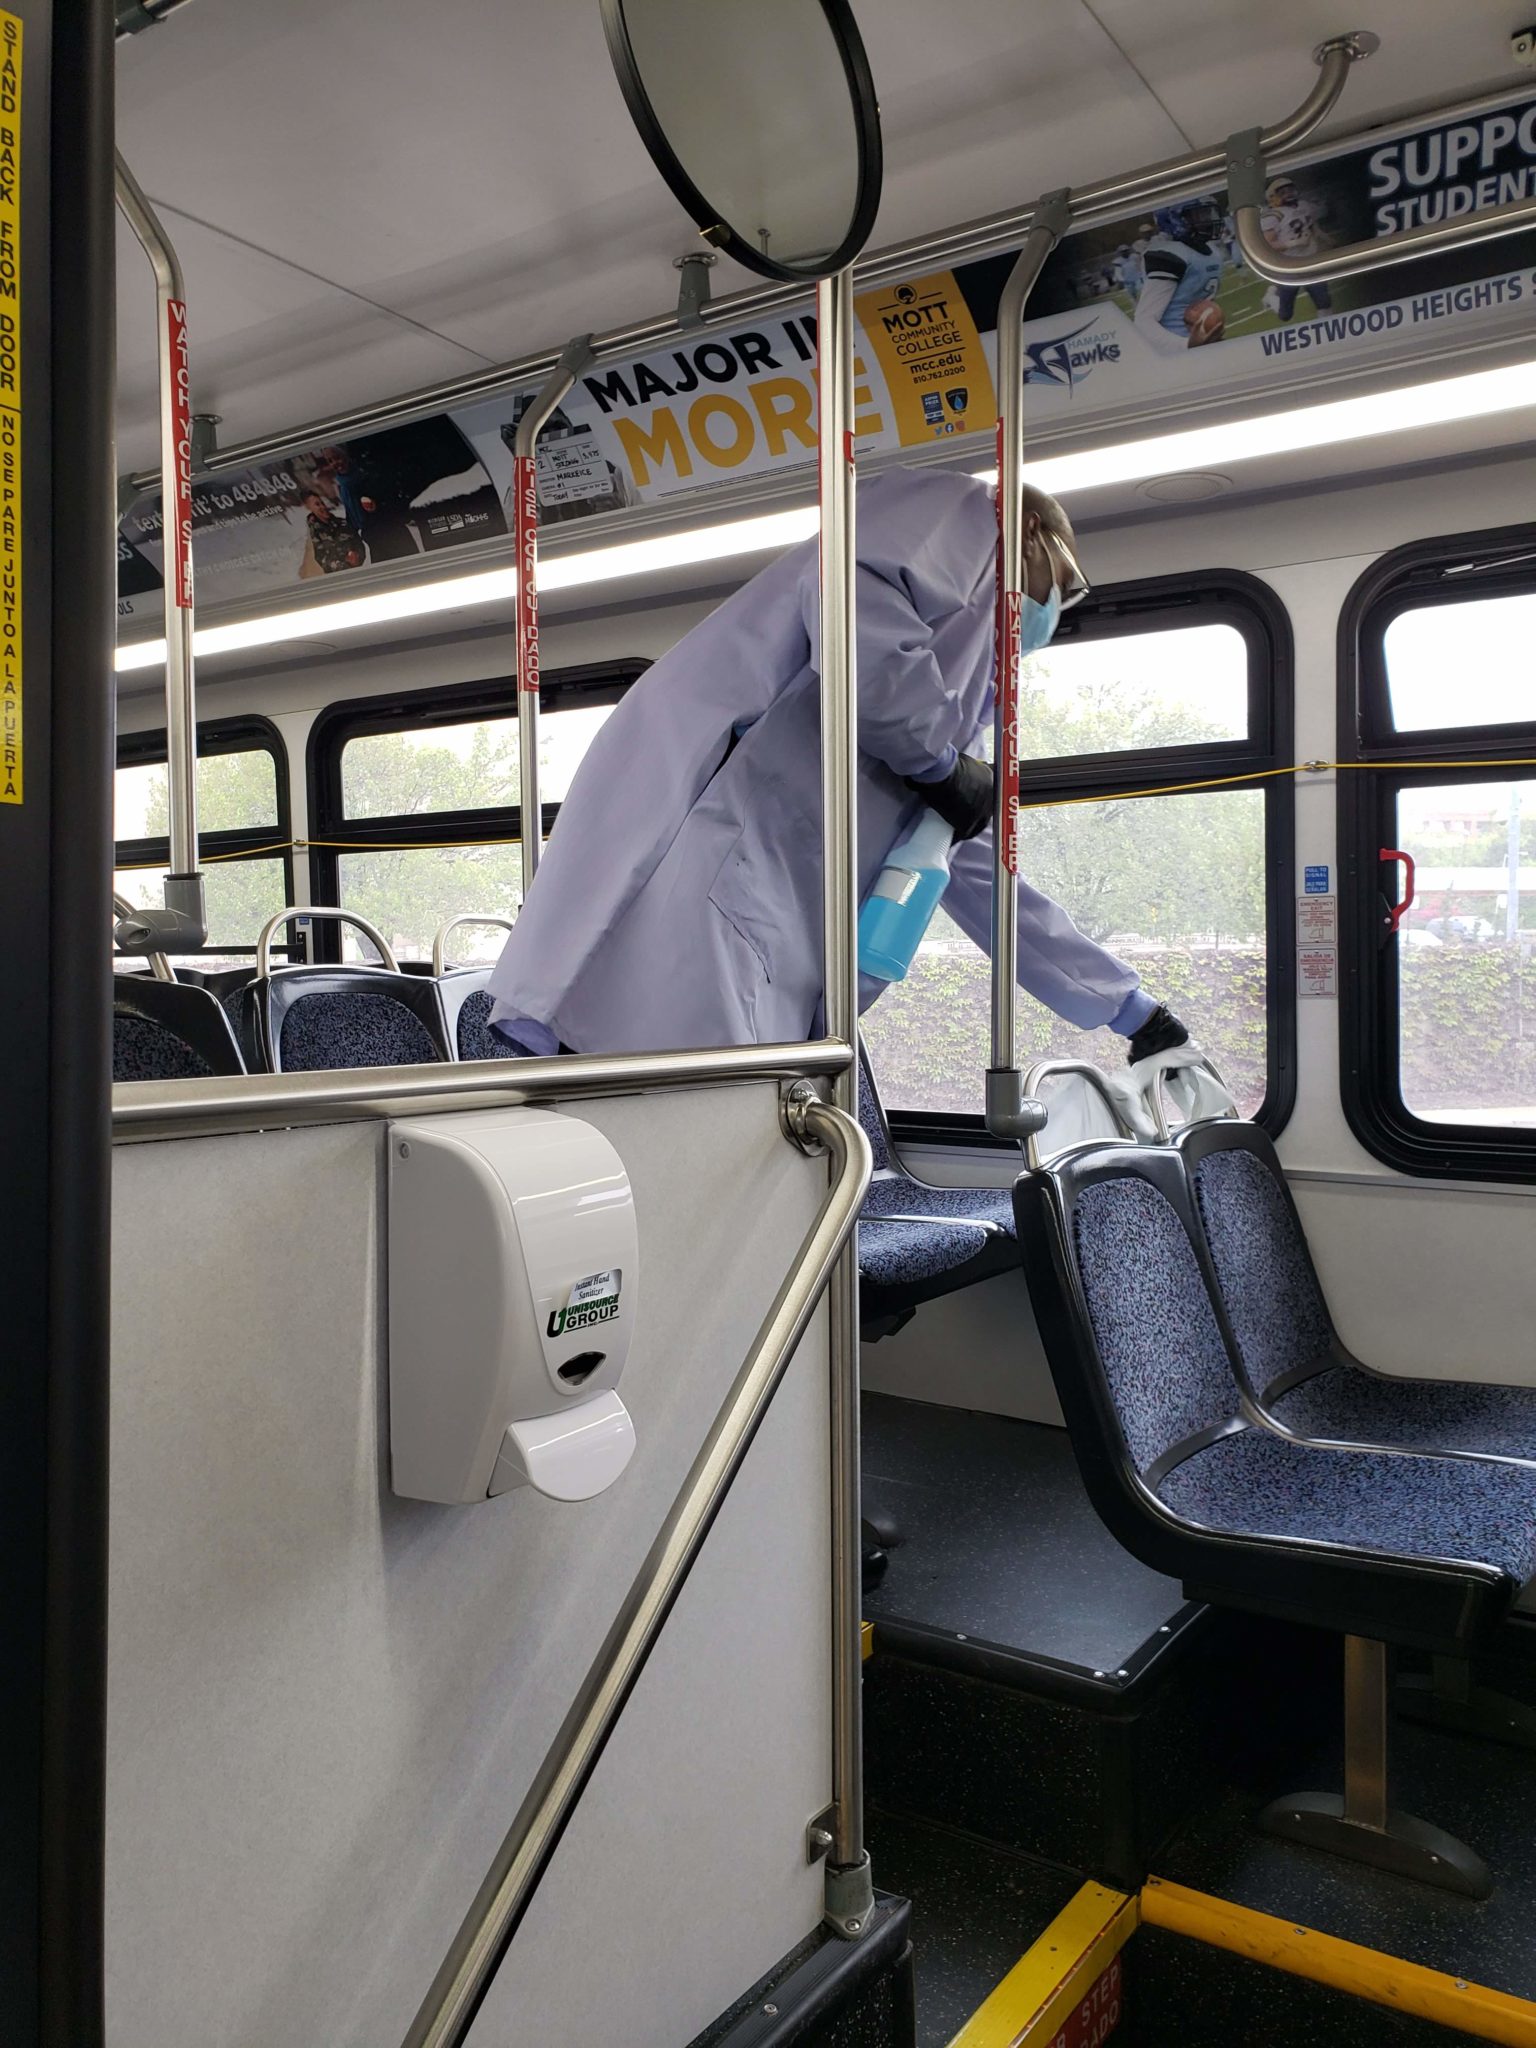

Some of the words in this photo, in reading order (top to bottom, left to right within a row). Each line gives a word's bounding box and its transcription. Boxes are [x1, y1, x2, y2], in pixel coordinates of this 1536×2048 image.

[2, 21, 17, 113] STAND
[1, 127, 16, 205] BACK
[0, 222, 16, 300] FROM
[881, 301, 950, 334] MOTT
[1261, 304, 1404, 356] WESTWOOD
[1412, 275, 1523, 323] HEIGHTS
[891, 319, 957, 344] COMMUNITY
[896, 330, 964, 357] COLLEGE
[1068, 330, 1117, 349] HAMADY
[0, 313, 16, 392] DOOR
[909, 353, 963, 375] mcc.edu
[582, 332, 783, 414] MAJOR
[913, 365, 966, 385] 810.762.0200
[2, 415, 16, 446] NO
[2, 452, 15, 483] SE
[212, 493, 234, 510] to
[232, 472, 298, 504] 484848
[2, 490, 15, 552] PARE
[259, 504, 284, 518] active
[2, 560, 16, 637] JUNTO
[526, 580, 540, 685] CUIDADO
[3, 643, 16, 658] A
[3, 664, 16, 695] LA
[3, 700, 17, 796] PUERTA
[577, 1287, 605, 1300] Sanitizer
[593, 1273, 610, 1286] Hand
[566, 1304, 619, 1329] GROUP
[567, 1293, 620, 1316] UNISOURCE
[1081, 1964, 1118, 2027] STEP
